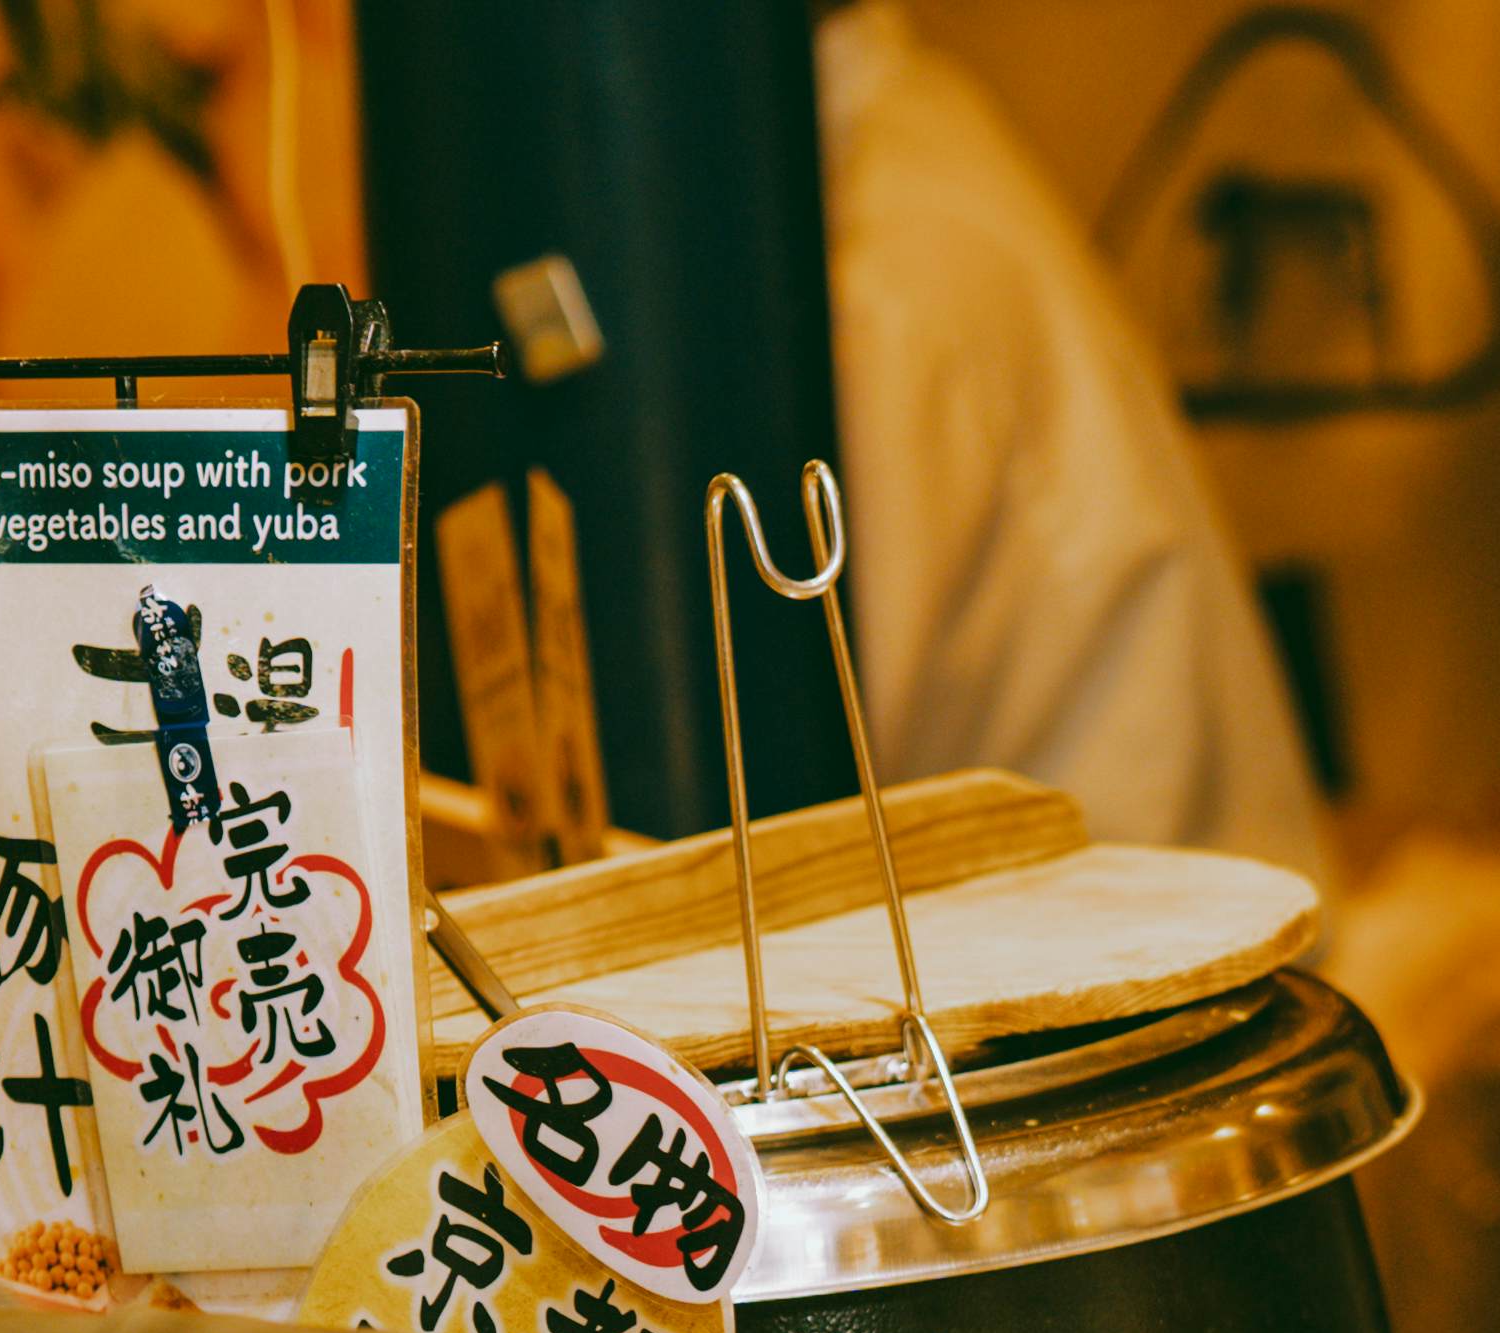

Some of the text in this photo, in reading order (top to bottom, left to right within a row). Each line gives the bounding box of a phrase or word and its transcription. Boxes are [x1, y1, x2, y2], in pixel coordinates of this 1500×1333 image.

[103, 461, 185, 499] soup
[197, 449, 271, 488] with
[283, 455, 367, 499] pork
[177, 503, 242, 542] and
[253, 503, 340, 552] yuba
[108, 908, 246, 1157] 御礼
[208, 781, 337, 1064] 完売
[481, 1041, 746, 1292] 名物
